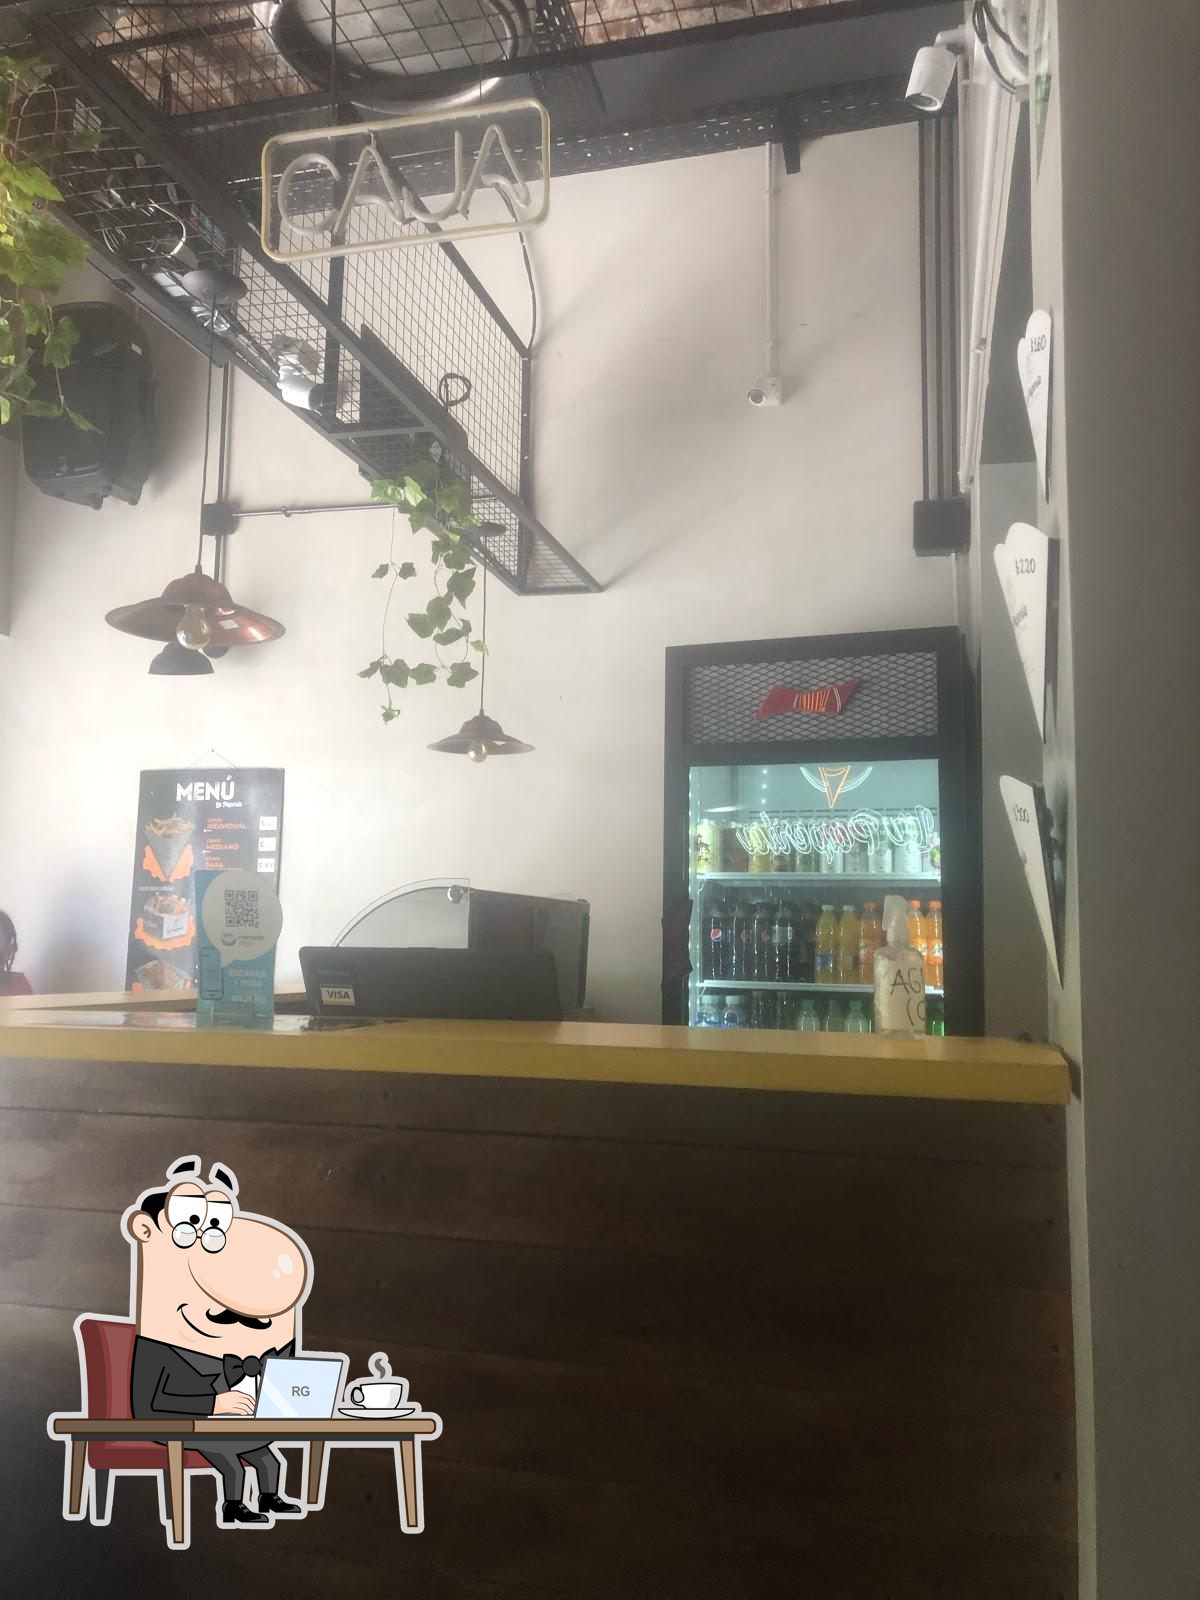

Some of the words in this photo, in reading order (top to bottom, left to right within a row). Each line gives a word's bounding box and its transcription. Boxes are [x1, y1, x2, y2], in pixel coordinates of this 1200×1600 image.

[277, 123, 531, 236] CAJA
[1014, 558, 1037, 577] $220
[176, 774, 235, 801] MENÚ
[327, 990, 351, 1000] VISA
